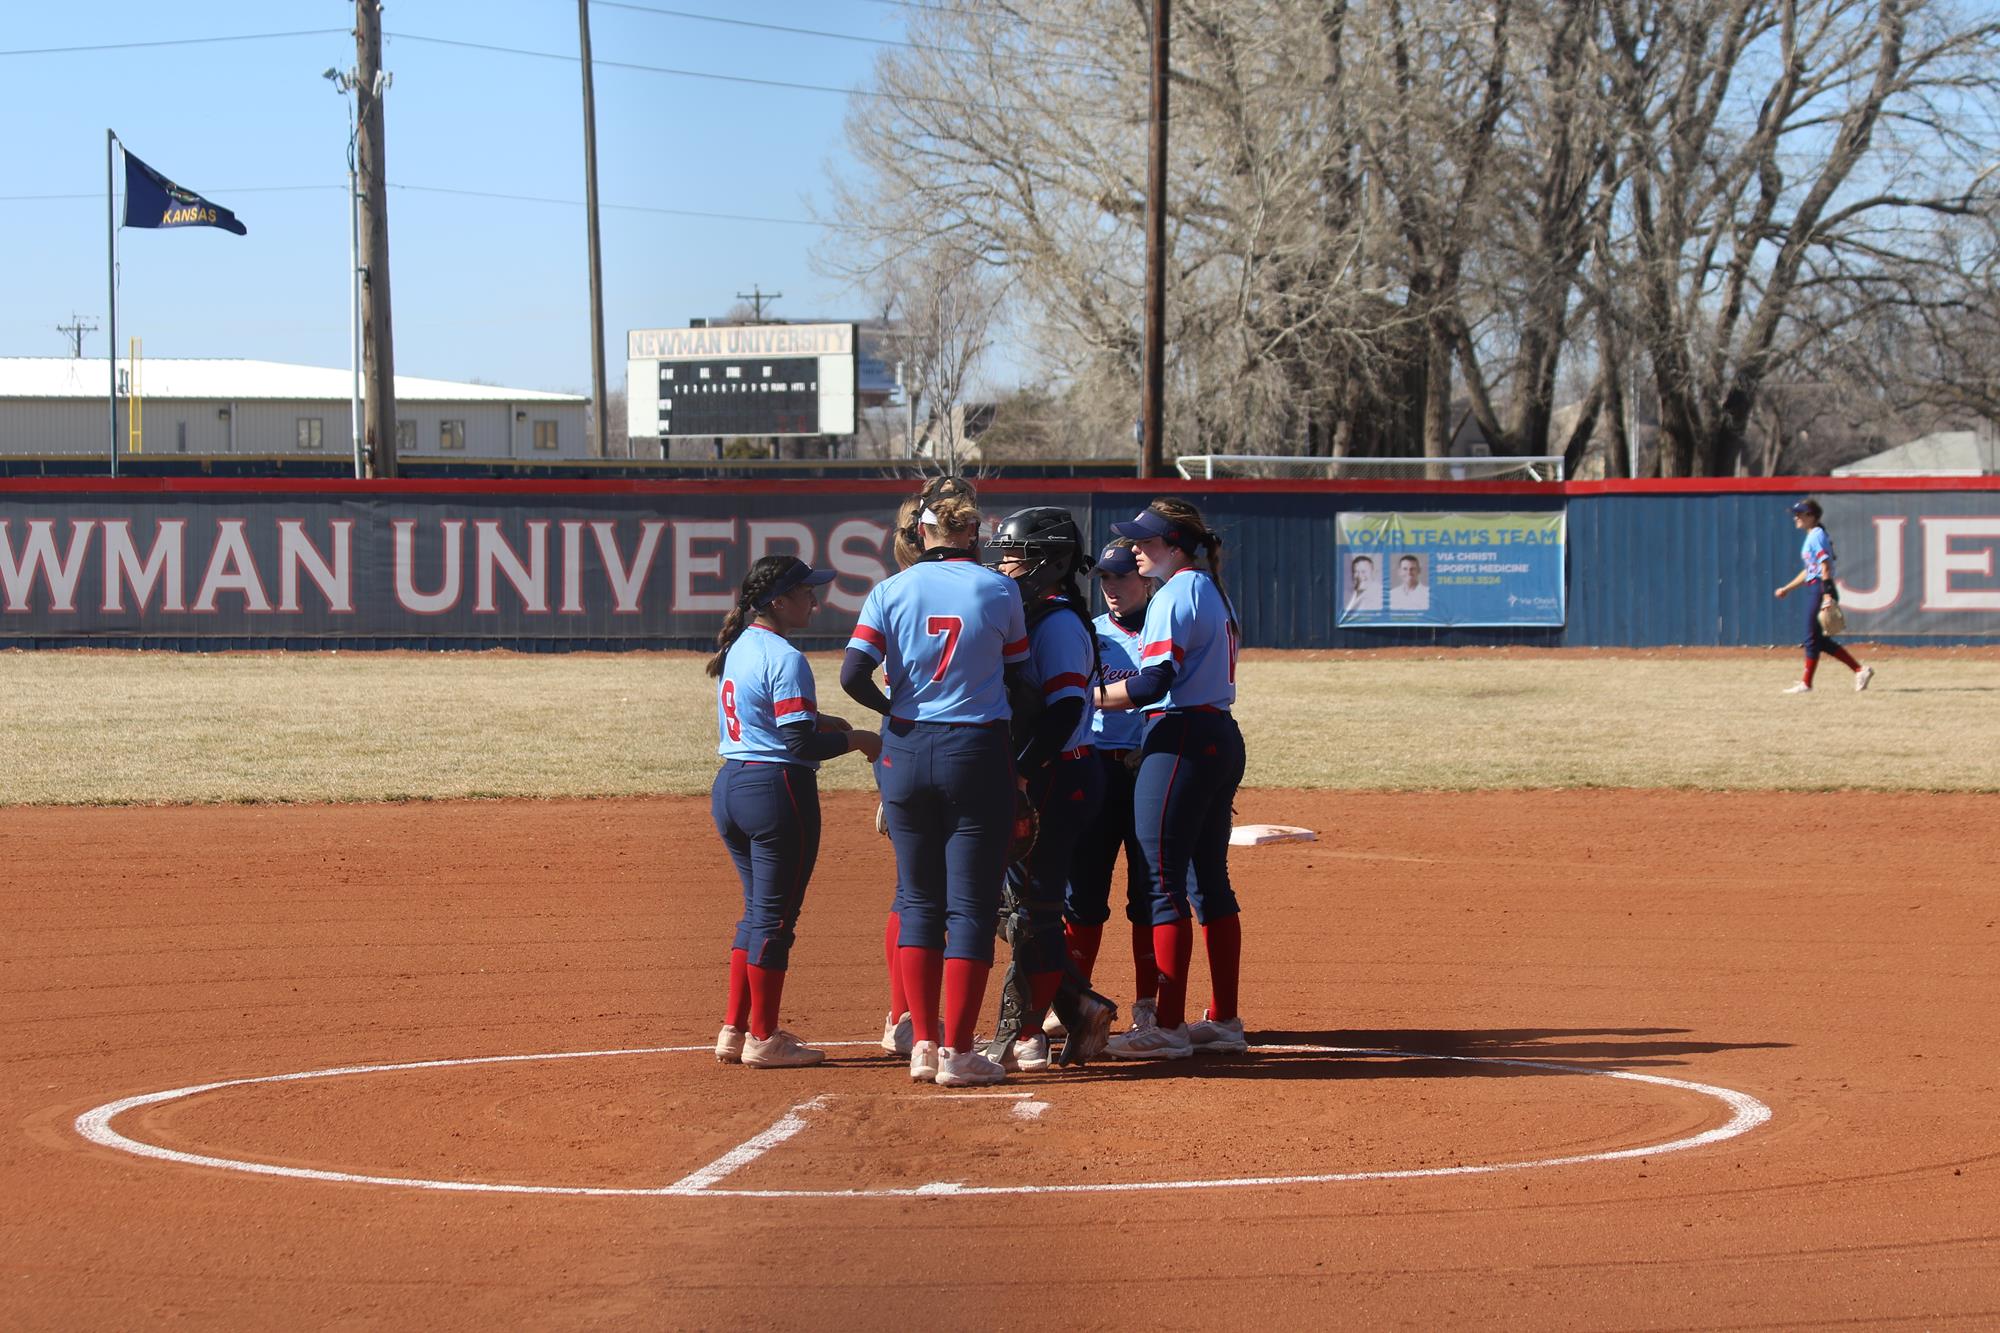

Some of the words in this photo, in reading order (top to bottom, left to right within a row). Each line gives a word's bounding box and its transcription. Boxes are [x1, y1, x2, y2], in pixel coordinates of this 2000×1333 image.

[163, 207, 217, 224] KANSAS
[631, 330, 723, 356] NEWMAN
[727, 326, 848, 354] UNIVERSITY
[1346, 528, 1405, 546] YOUR
[1411, 528, 1491, 545] TEAM'S
[1496, 528, 1558, 545] TEAM
[0, 517, 356, 616] WMAN
[391, 516, 1000, 615] UNIVERS
[1436, 552, 1454, 561] VIA
[1456, 552, 1498, 561] CHRISTI
[1436, 563, 1477, 573] SPORTS
[1479, 563, 1529, 573] MEDICINE
[925, 614, 964, 683] 7
[721, 678, 742, 743] 8
